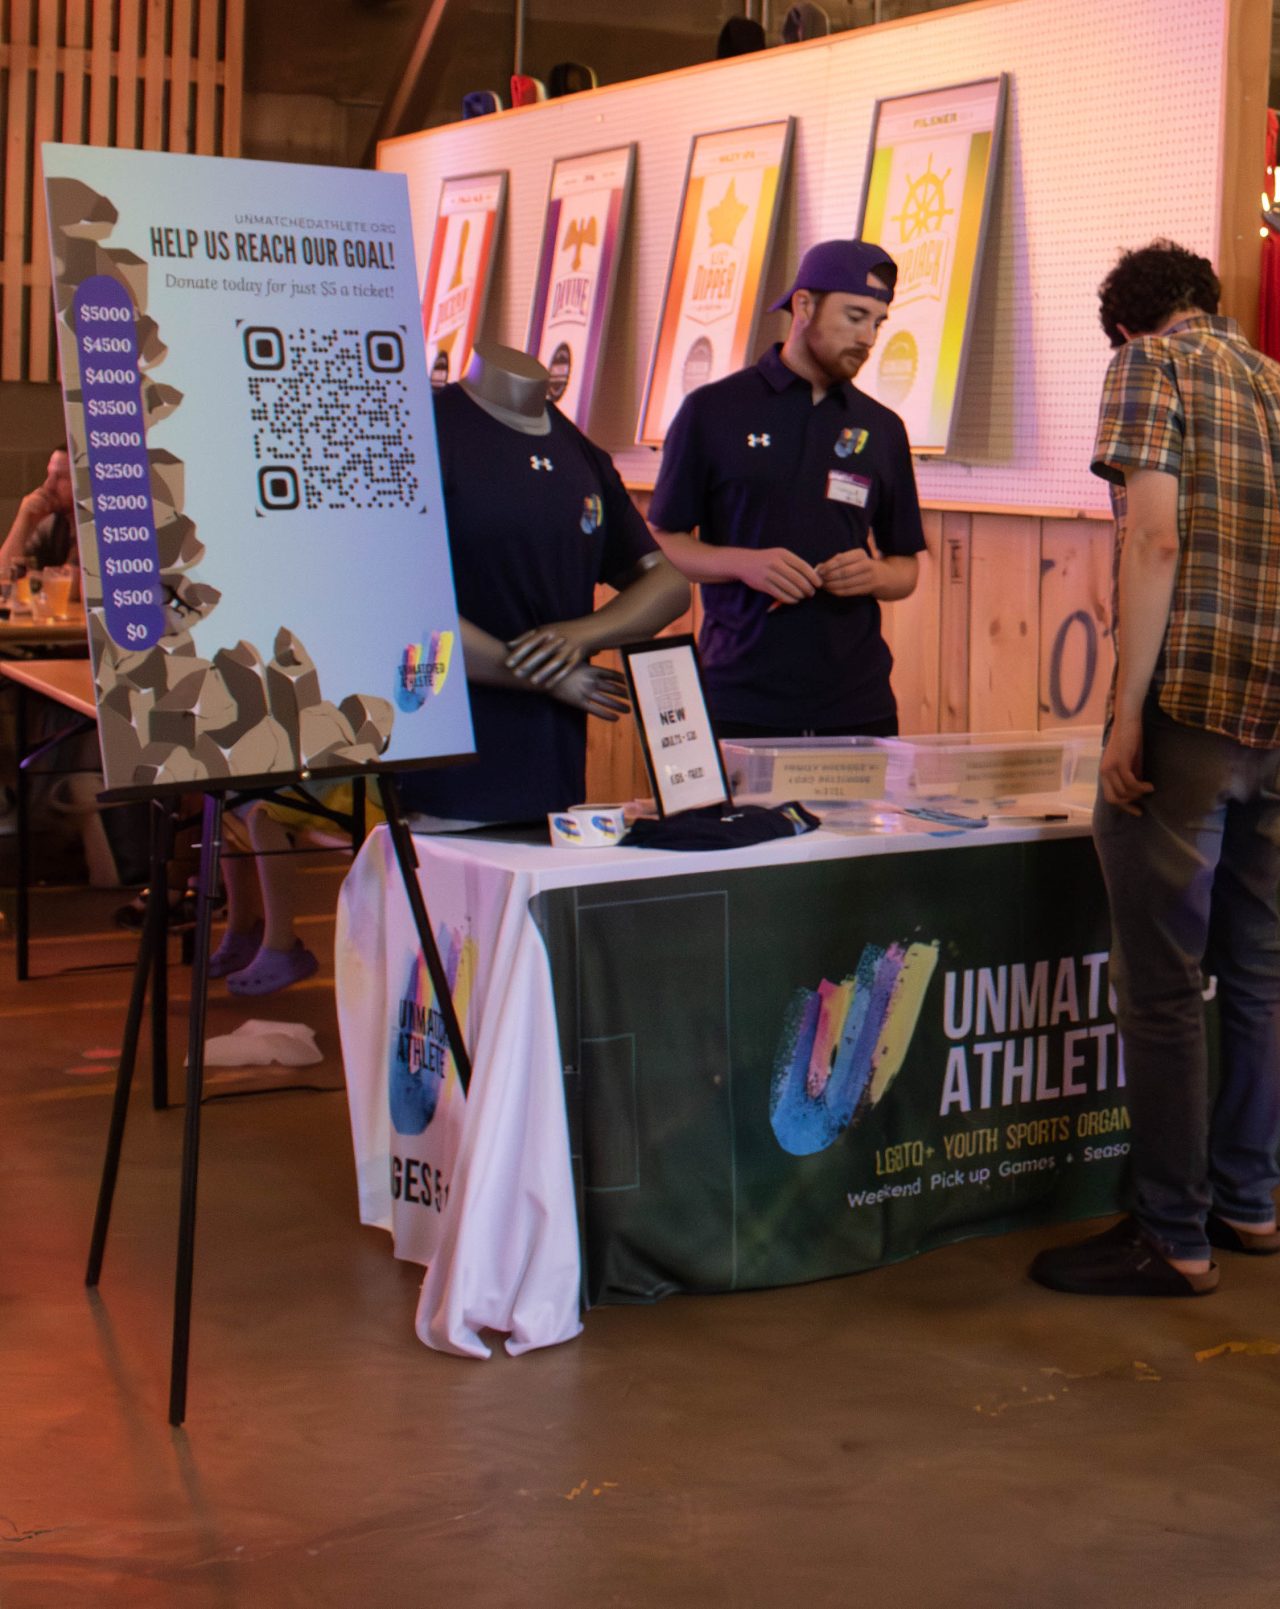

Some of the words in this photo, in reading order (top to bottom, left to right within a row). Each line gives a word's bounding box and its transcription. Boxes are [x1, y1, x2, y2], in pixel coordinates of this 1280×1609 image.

[234, 214, 397, 234] UNMATCHEDATHLETE.ORG
[150, 226, 198, 258] HELP
[204, 230, 230, 260] US
[235, 232, 297, 264] REACH
[302, 236, 339, 267] OUR
[344, 239, 395, 270] GOAL!
[165, 273, 218, 291] Donate
[223, 275, 262, 296] today
[266, 278, 286, 296] for
[290, 281, 316, 298] just
[320, 281, 337, 297] $5
[340, 285, 349, 297] a
[353, 284, 395, 299] ticket!
[692, 261, 736, 300] DIPPER
[80, 304, 131, 322] $5000
[83, 336, 132, 353] $4500
[85, 368, 136, 385] $4000
[88, 399, 137, 416] $3500
[90, 431, 141, 448] $3000
[94, 463, 143, 480] $2500
[97, 494, 148, 511] $2000
[103, 526, 149, 542] $1500
[105, 558, 153, 575] $1000
[113, 589, 153, 607] $500
[126, 623, 148, 640] $0
[659, 707, 686, 726] NEW
[943, 952, 1119, 1039] UNMAT
[875, 1141, 935, 1176] LGBTQ+
[943, 1128, 998, 1160] YOUTH
[1006, 1116, 1070, 1150] SPORTS
[847, 1178, 922, 1208] Weekend
[931, 1169, 964, 1190] Pick
[969, 1167, 990, 1185] up
[999, 1155, 1055, 1178] Games
[1083, 1142, 1131, 1163] Seaso
